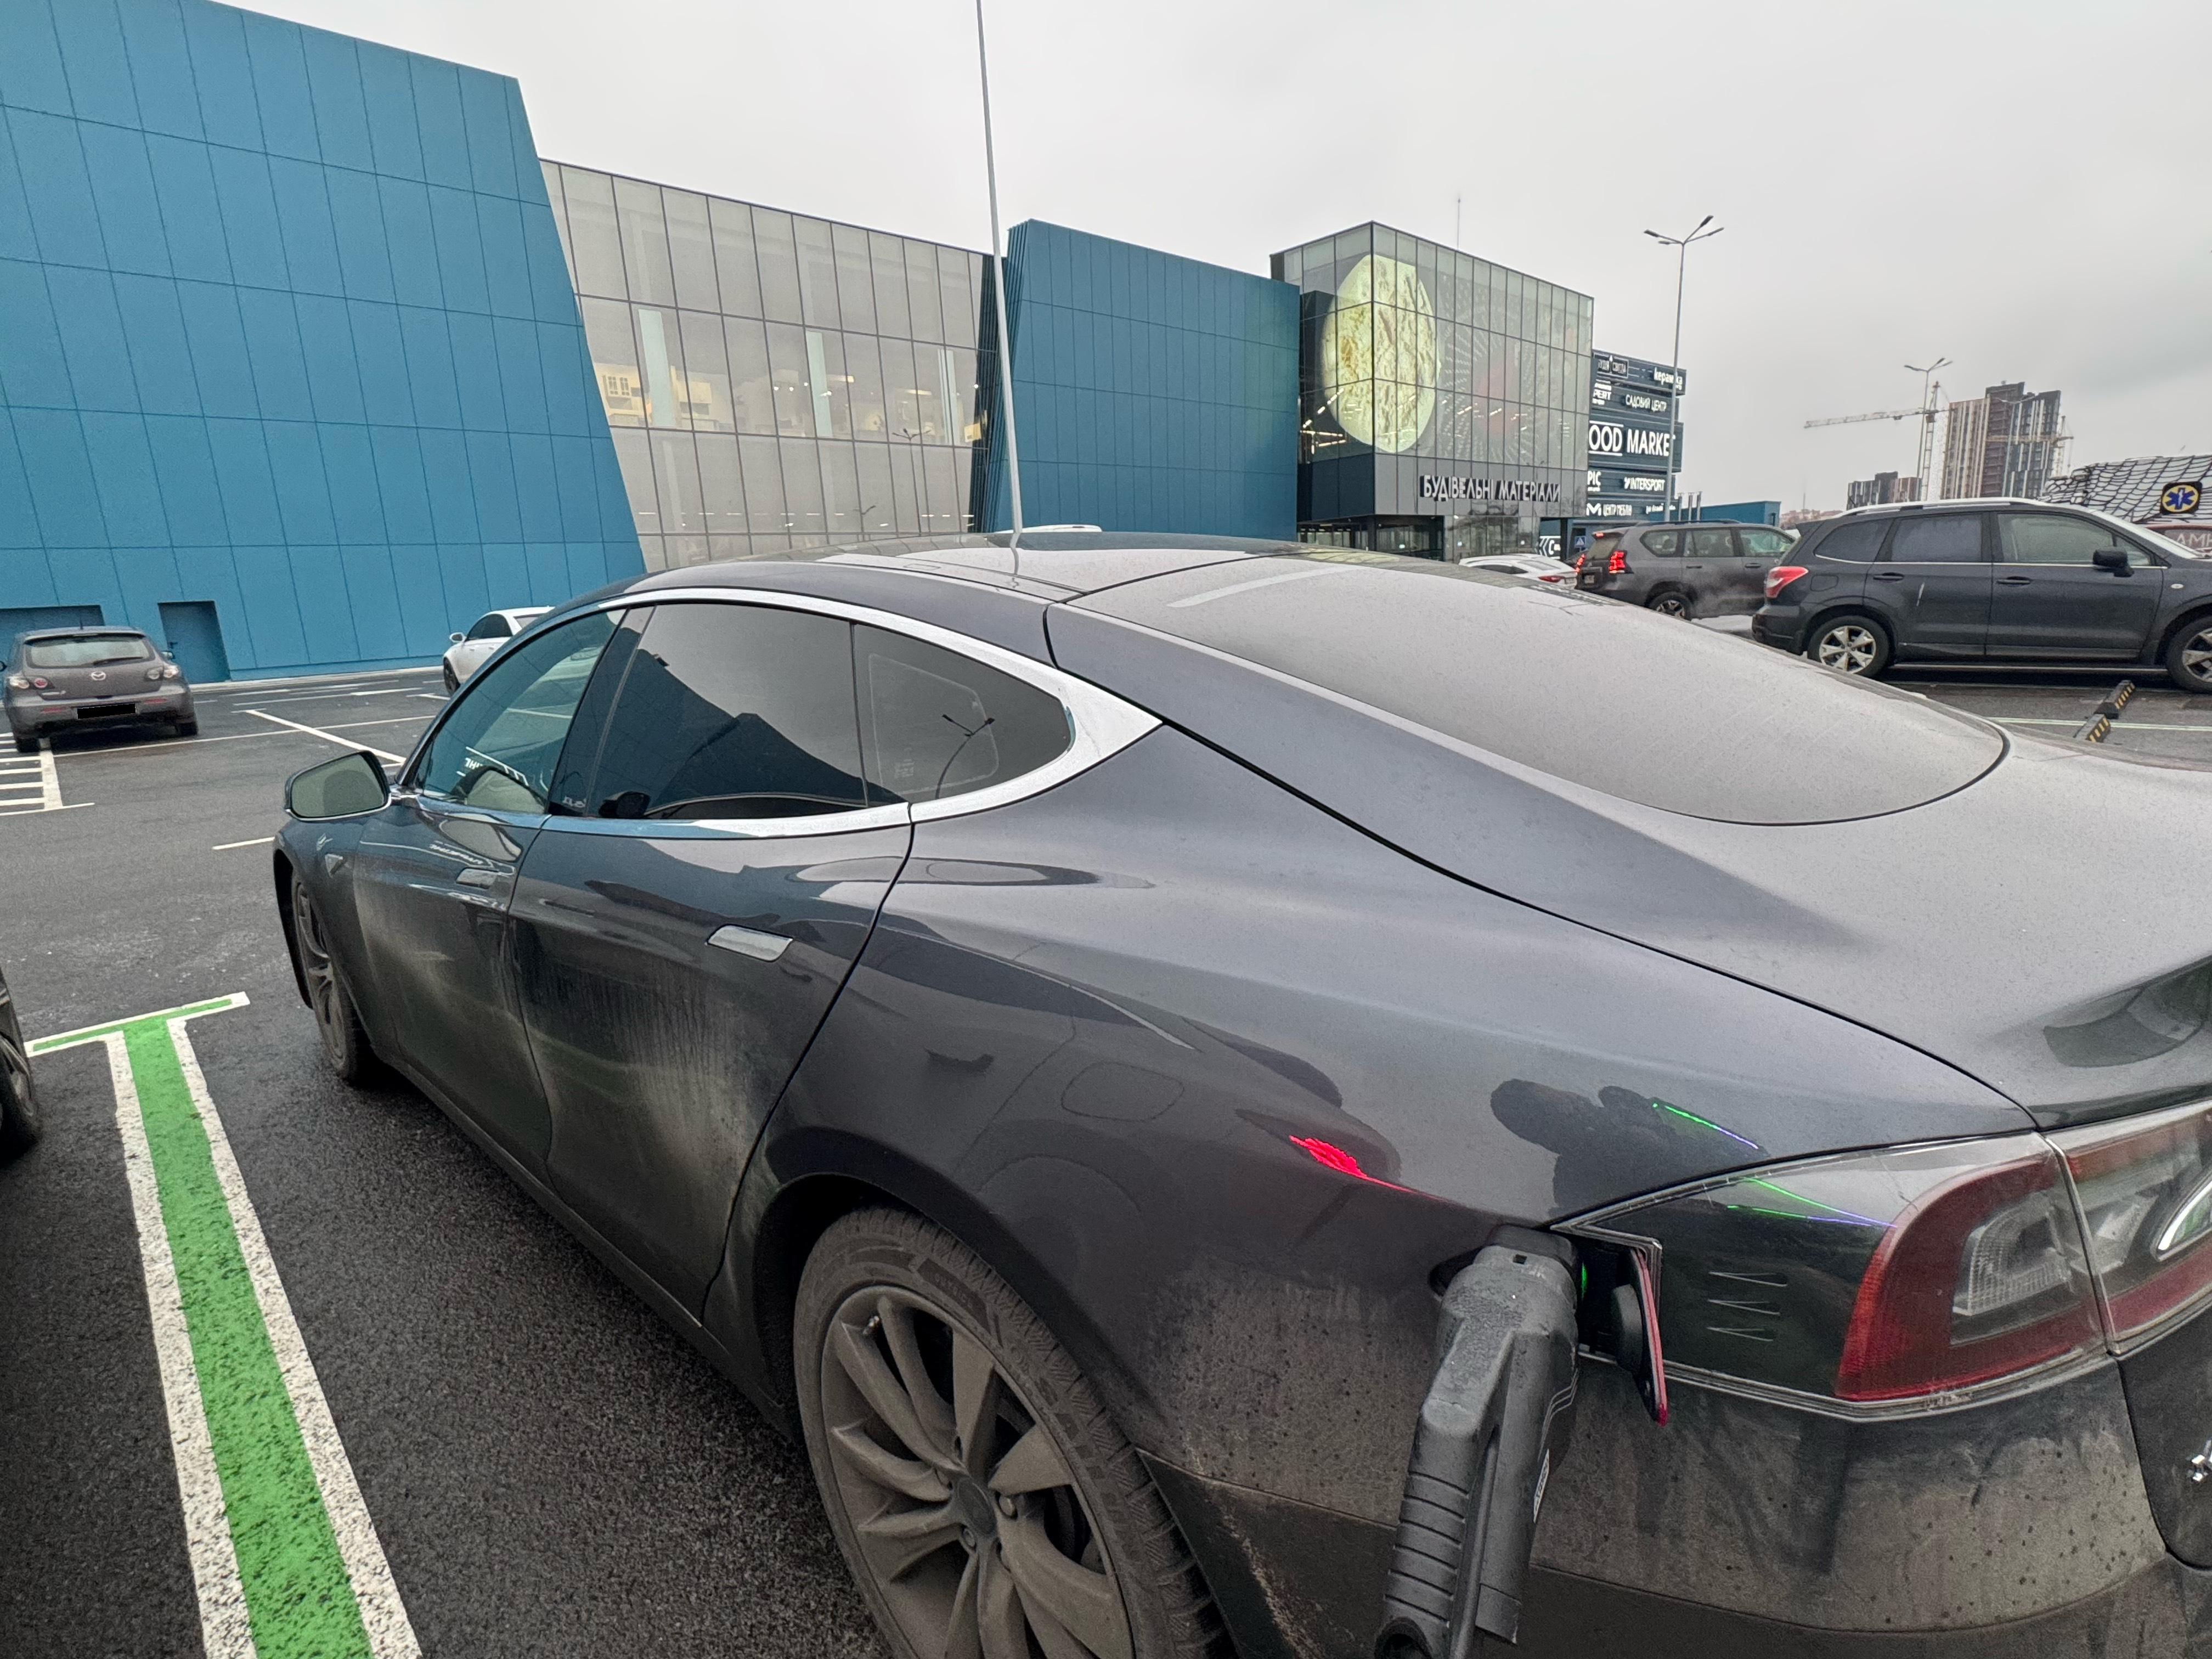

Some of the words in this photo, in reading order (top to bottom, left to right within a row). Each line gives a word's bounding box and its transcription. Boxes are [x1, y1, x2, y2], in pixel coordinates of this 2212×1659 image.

[1589, 425, 1623, 452] OOD
[1423, 475, 1494, 502] БУДІВЕЛЬНІ
[1498, 479, 1561, 503] МАТЕРІАЛИ
[1629, 477, 1666, 492] INTERSPORT
